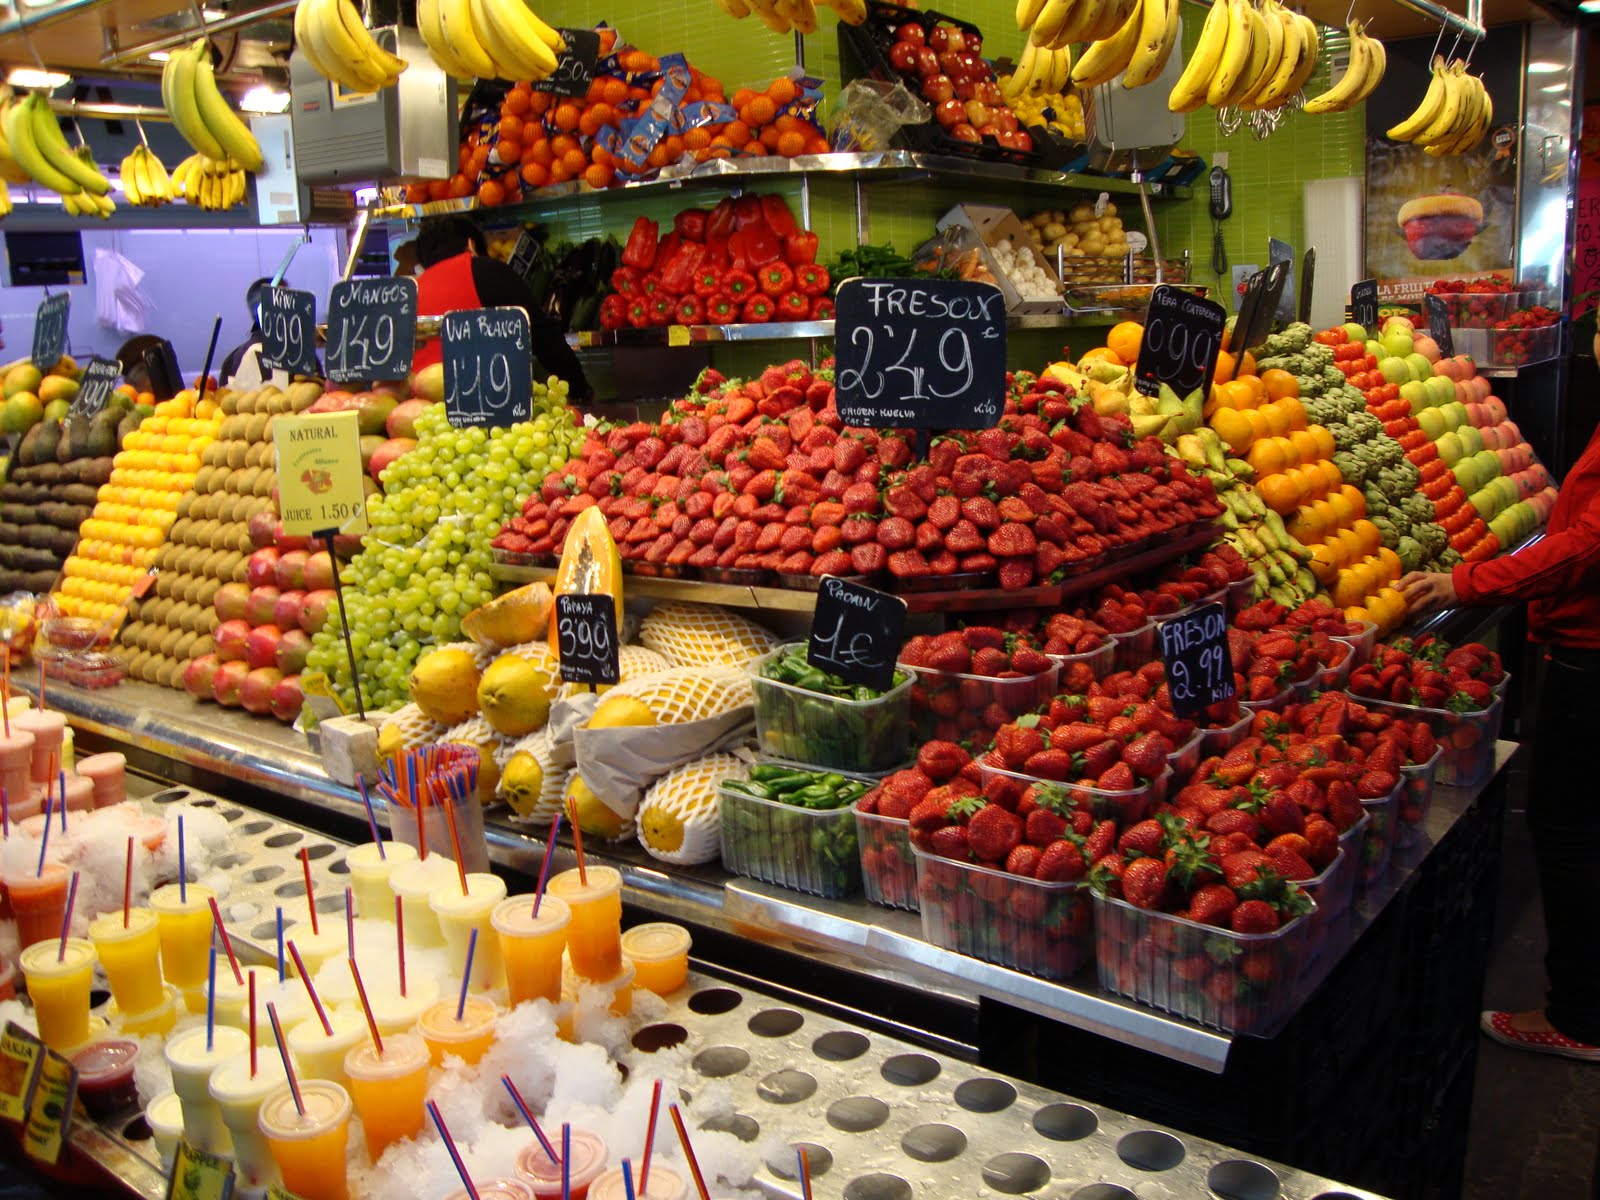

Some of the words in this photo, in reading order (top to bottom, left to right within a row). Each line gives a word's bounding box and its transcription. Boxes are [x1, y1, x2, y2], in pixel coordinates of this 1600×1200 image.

[340, 282, 408, 307] MANGOS
[289, 425, 338, 442] NATURAL
[284, 508, 312, 521] JUICE
[320, 502, 349, 520] 1.50
[560, 595, 593, 615] PAPAYA
[1162, 612, 1226, 656] FRESON
